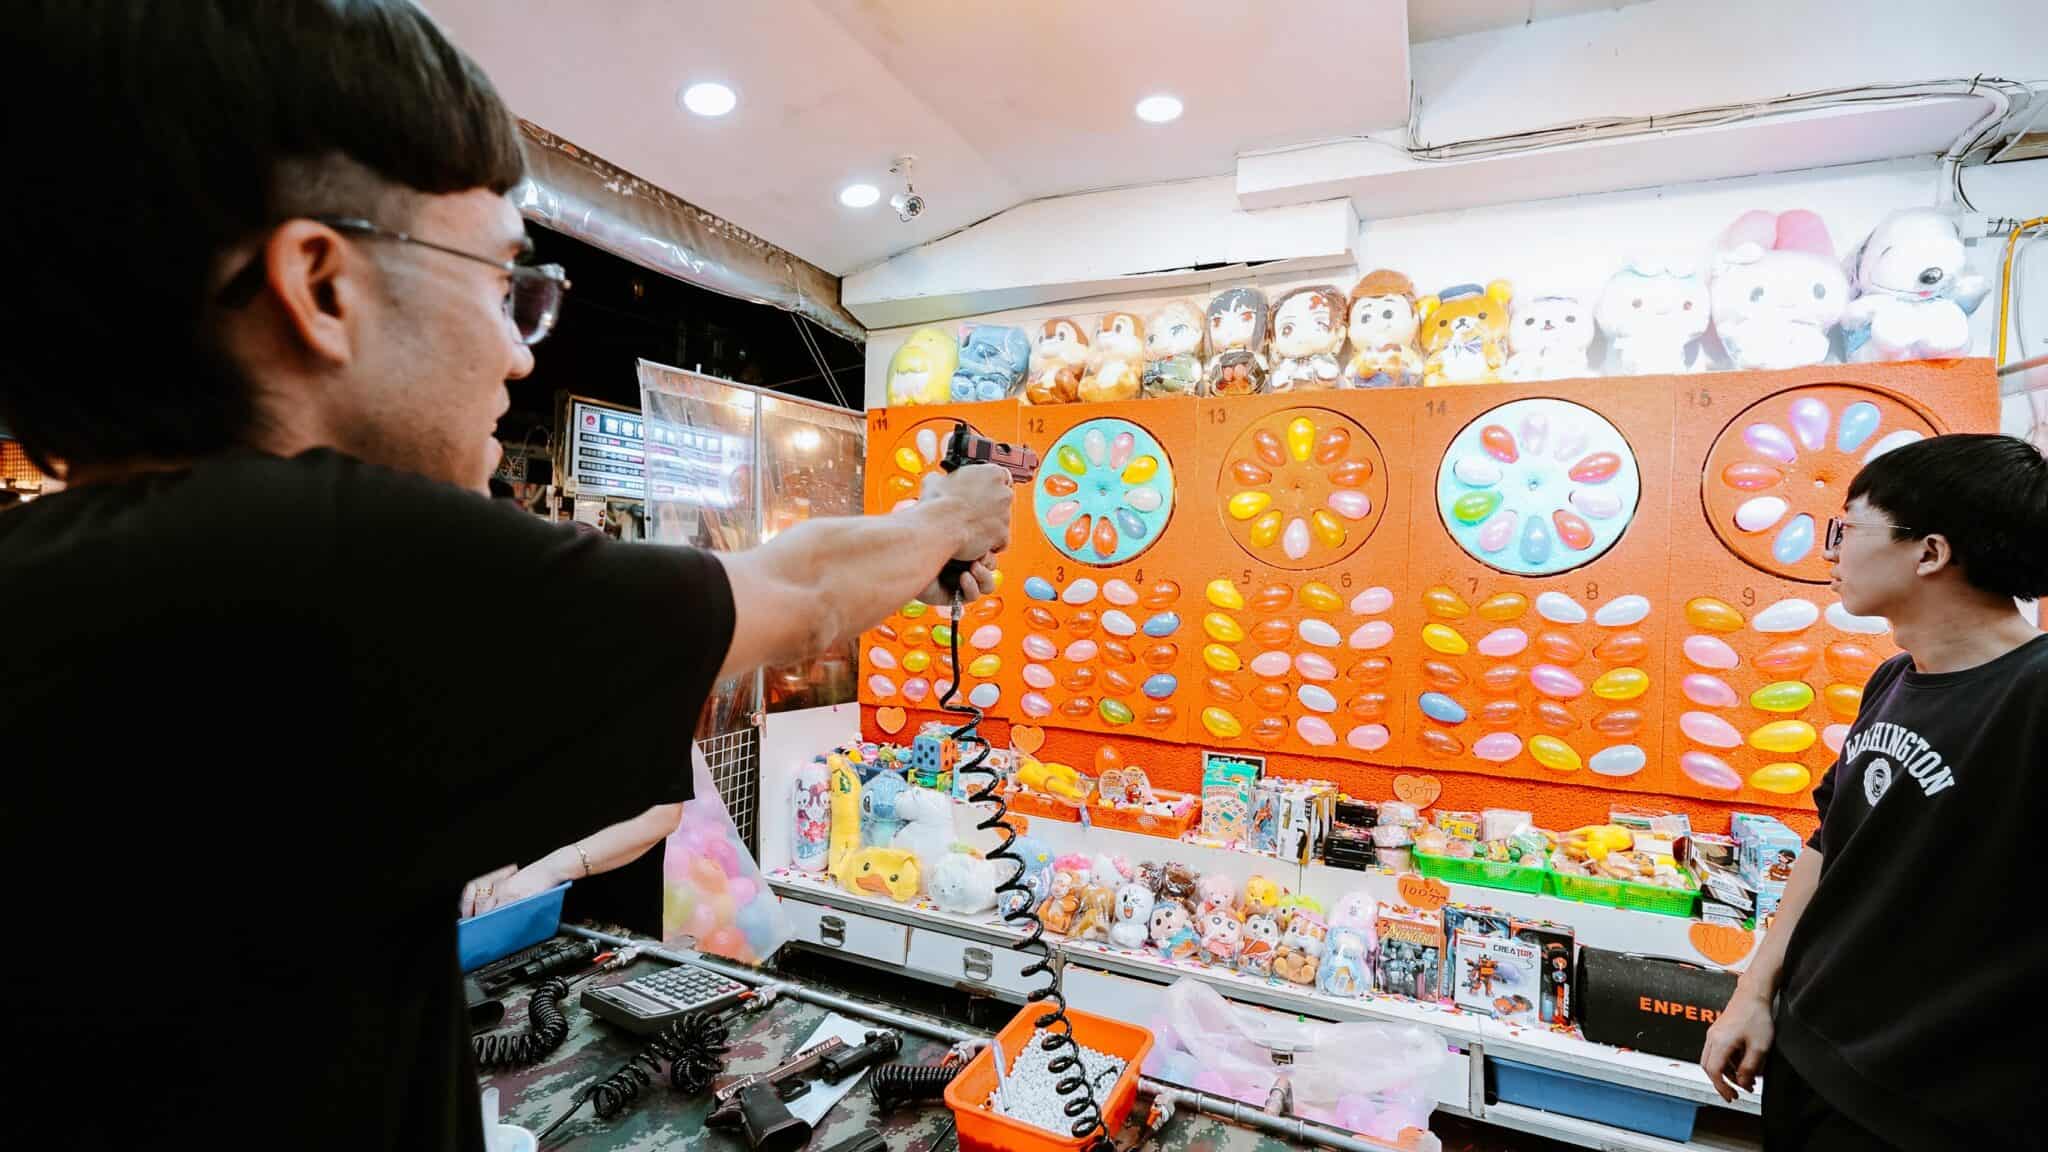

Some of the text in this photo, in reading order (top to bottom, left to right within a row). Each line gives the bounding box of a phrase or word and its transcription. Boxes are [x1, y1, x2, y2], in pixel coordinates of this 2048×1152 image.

[1688, 389, 1712, 408] 15
[1208, 408, 1227, 425] 13
[1426, 400, 1447, 416] 14
[1028, 418, 1044, 434] 12
[1056, 566, 1066, 584] 3
[1134, 568, 1145, 585] 4
[1242, 570, 1252, 586] 5
[1341, 573, 1352, 589] 6
[1468, 577, 1480, 595] 7
[1586, 582, 1599, 601] 8
[1742, 586, 1756, 607] 9
[1845, 722, 1955, 797] WAHINGTON
[1640, 997, 1720, 1025] ENPER
